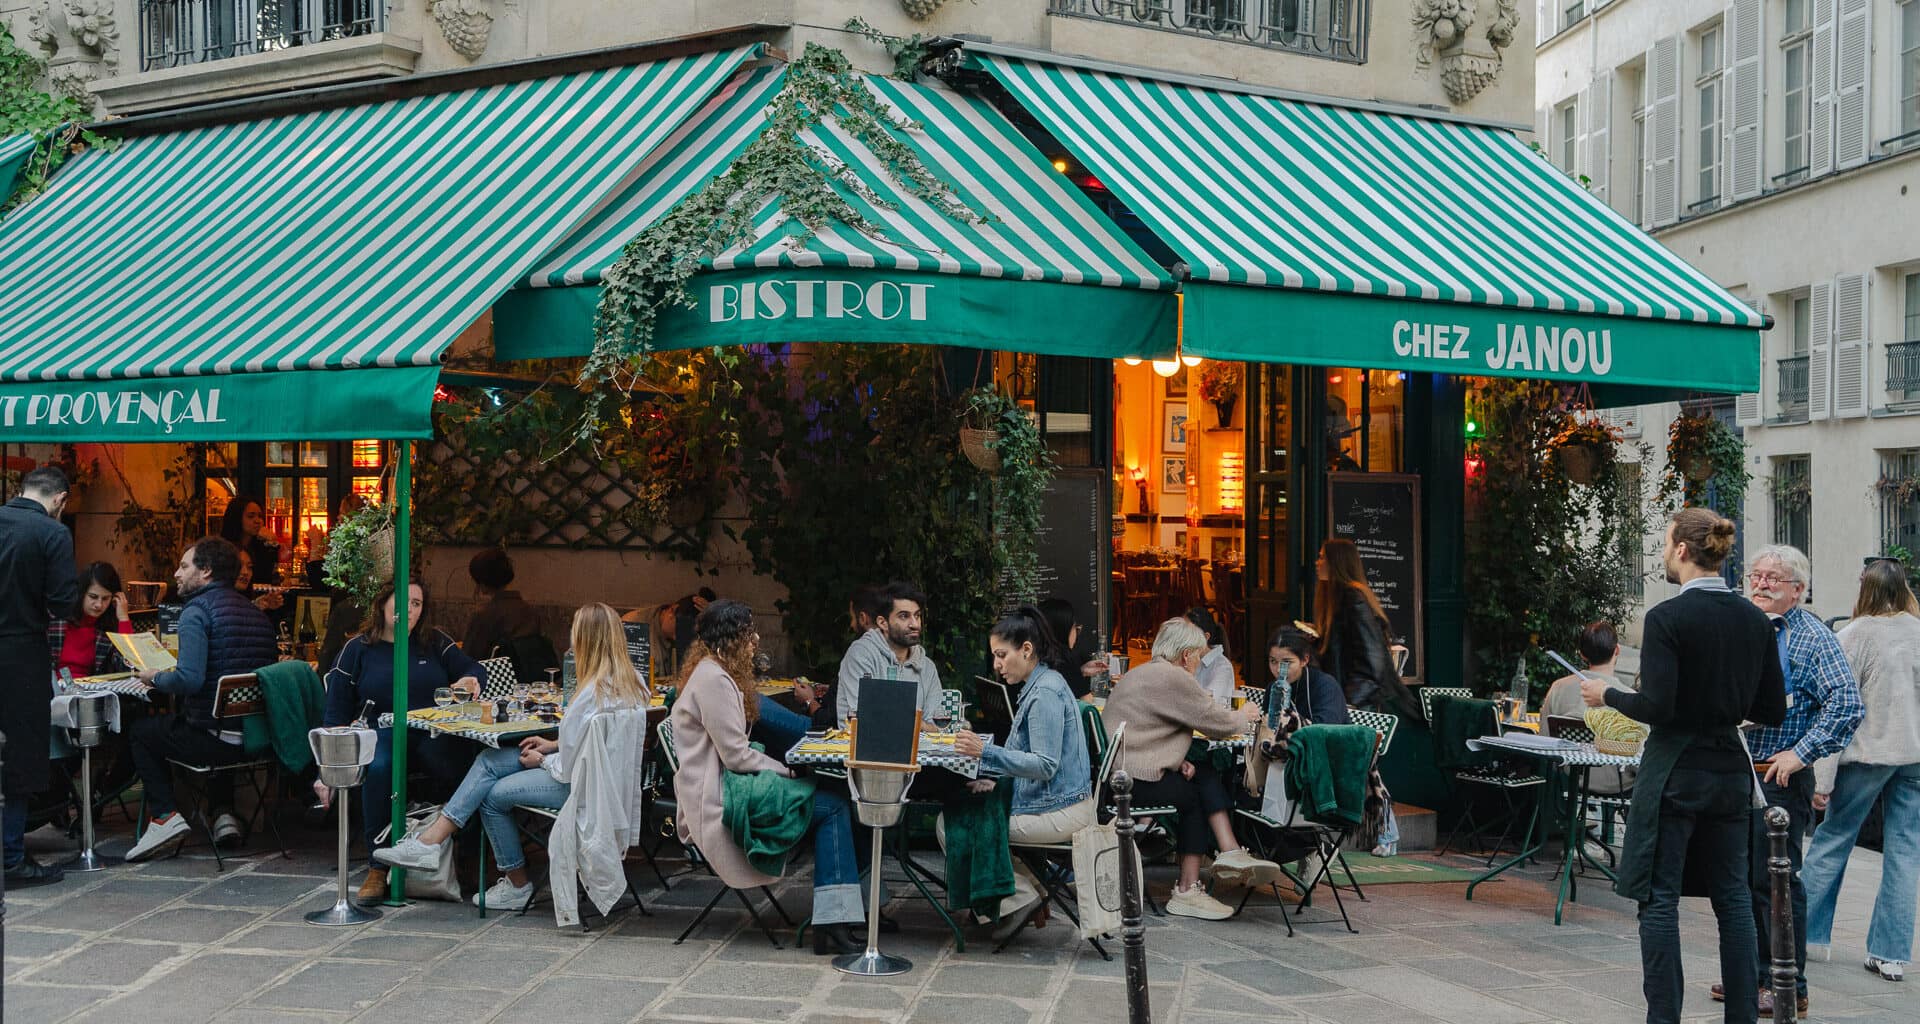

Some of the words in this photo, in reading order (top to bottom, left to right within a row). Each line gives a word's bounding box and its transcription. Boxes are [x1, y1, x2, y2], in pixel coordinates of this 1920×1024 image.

[710, 280, 935, 323] BISTROT
[1392, 319, 1470, 359] CHEZ
[1485, 323, 1612, 375] JANOU
[0, 396, 25, 426] T
[26, 388, 226, 433] PROVENÇAL
